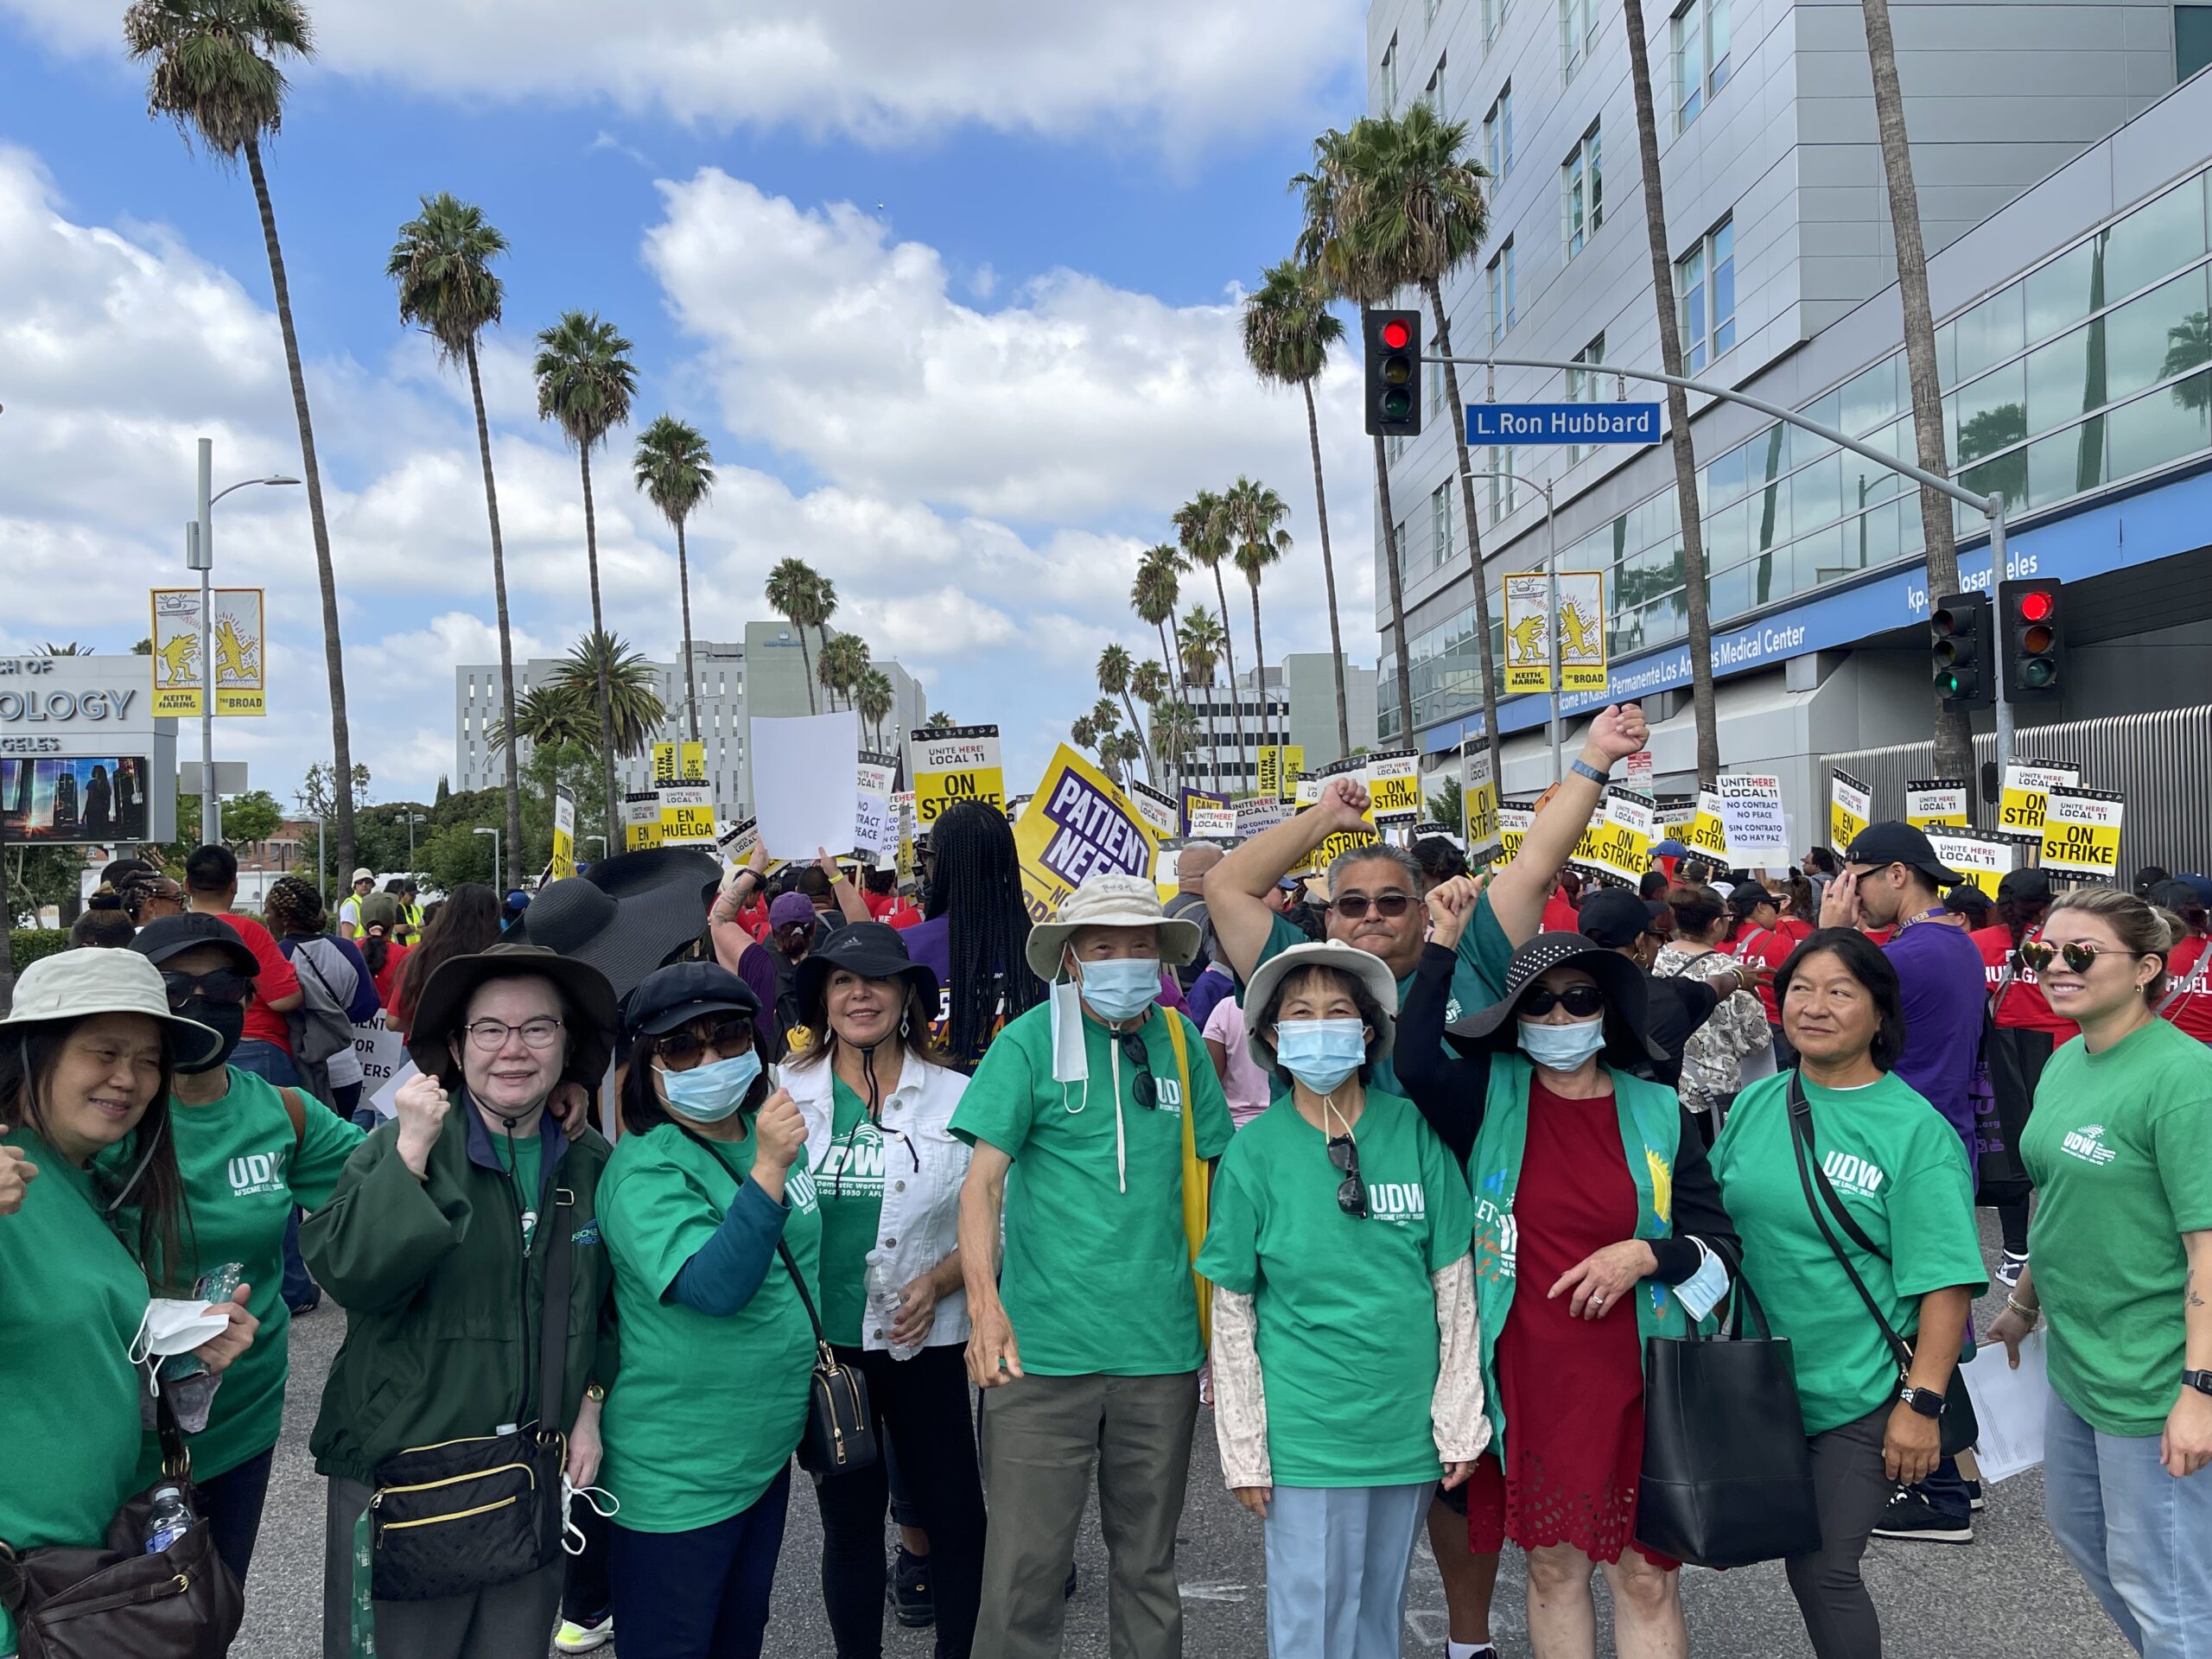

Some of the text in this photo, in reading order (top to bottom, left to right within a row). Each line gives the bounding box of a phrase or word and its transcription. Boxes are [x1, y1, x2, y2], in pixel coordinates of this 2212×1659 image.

[1478, 410, 1649, 434] L. Ron Hubbard
[25, 660, 54, 674] OF
[1580, 691, 1588, 705] to
[1611, 668, 1660, 696] Permanente
[1661, 661, 1676, 683] Los
[1679, 652, 1719, 677] Anes
[1720, 638, 1762, 665] Medical
[1764, 626, 1806, 652] Center
[1574, 674, 1604, 683] BROAD
[229, 698, 262, 708] BROAD
[929, 745, 983, 755] UNITE HERE!
[929, 754, 969, 765] LOCAL
[944, 773, 976, 796] ON
[1386, 779, 1405, 794] ON
[2018, 778, 2050, 787] LOCAL
[1722, 789, 1768, 798] LOCAL
[858, 801, 868, 811] NO
[1617, 804, 1630, 814] UNITE
[1839, 795, 1854, 809] LOCAL
[2025, 793, 2047, 810] ON
[2061, 802, 2083, 810] UNITE
[677, 810, 694, 822] EN
[1141, 805, 1159, 822] LOCAL
[1237, 806, 1268, 817] OCAL
[1615, 810, 1635, 824] LOCAL
[2004, 807, 2045, 827] STRI
[2060, 809, 2093, 819] LOCAL
[662, 823, 713, 836] HUELGA
[1052, 776, 1148, 878] PATIENT
[1842, 813, 1853, 833] EN
[638, 826, 649, 841] EN
[1669, 826, 1683, 837] ON
[2067, 826, 2094, 845] ON
[734, 838, 758, 853] LOCAL
[1505, 834, 1522, 849] ON
[1617, 830, 1635, 850] ON
[562, 836, 570, 860] ON
[1940, 843, 1995, 856] UNITE HERE!
[2045, 841, 2113, 864] STRIKE
[1601, 842, 1643, 874] STRIKE
[1940, 851, 1995, 866] LOCAL 11
[1911, 911, 1929, 924] SEIU
[2063, 1131, 2097, 1156] UDW
[1822, 1150, 1884, 1192] UDW
[1370, 1183, 1425, 1213] UDW
